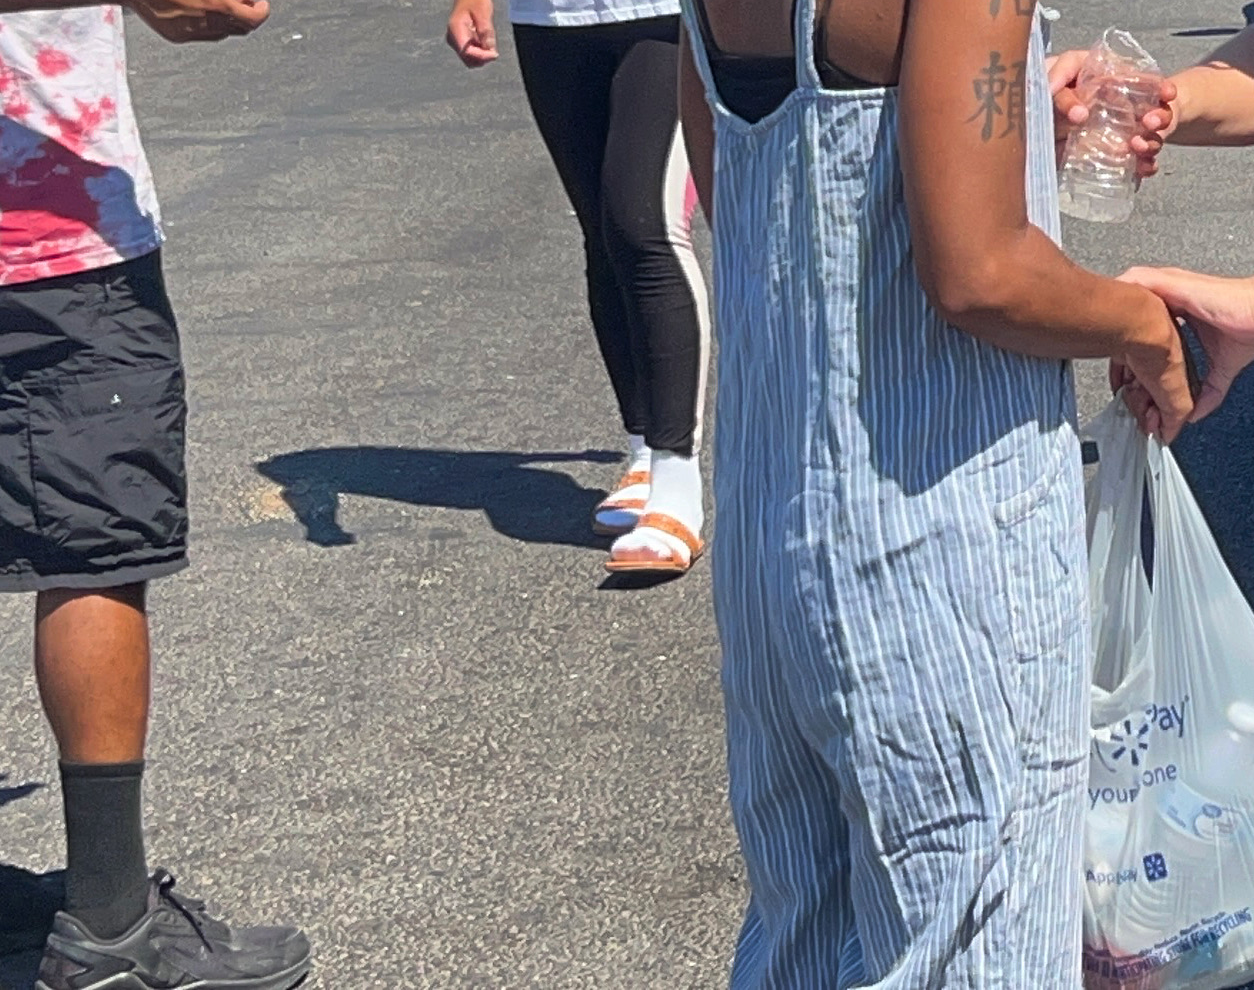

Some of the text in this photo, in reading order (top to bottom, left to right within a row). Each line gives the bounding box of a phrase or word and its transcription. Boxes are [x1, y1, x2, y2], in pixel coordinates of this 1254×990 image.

[1088, 764, 1177, 811] your one
[1210, 909, 1253, 942] RECYCLING
